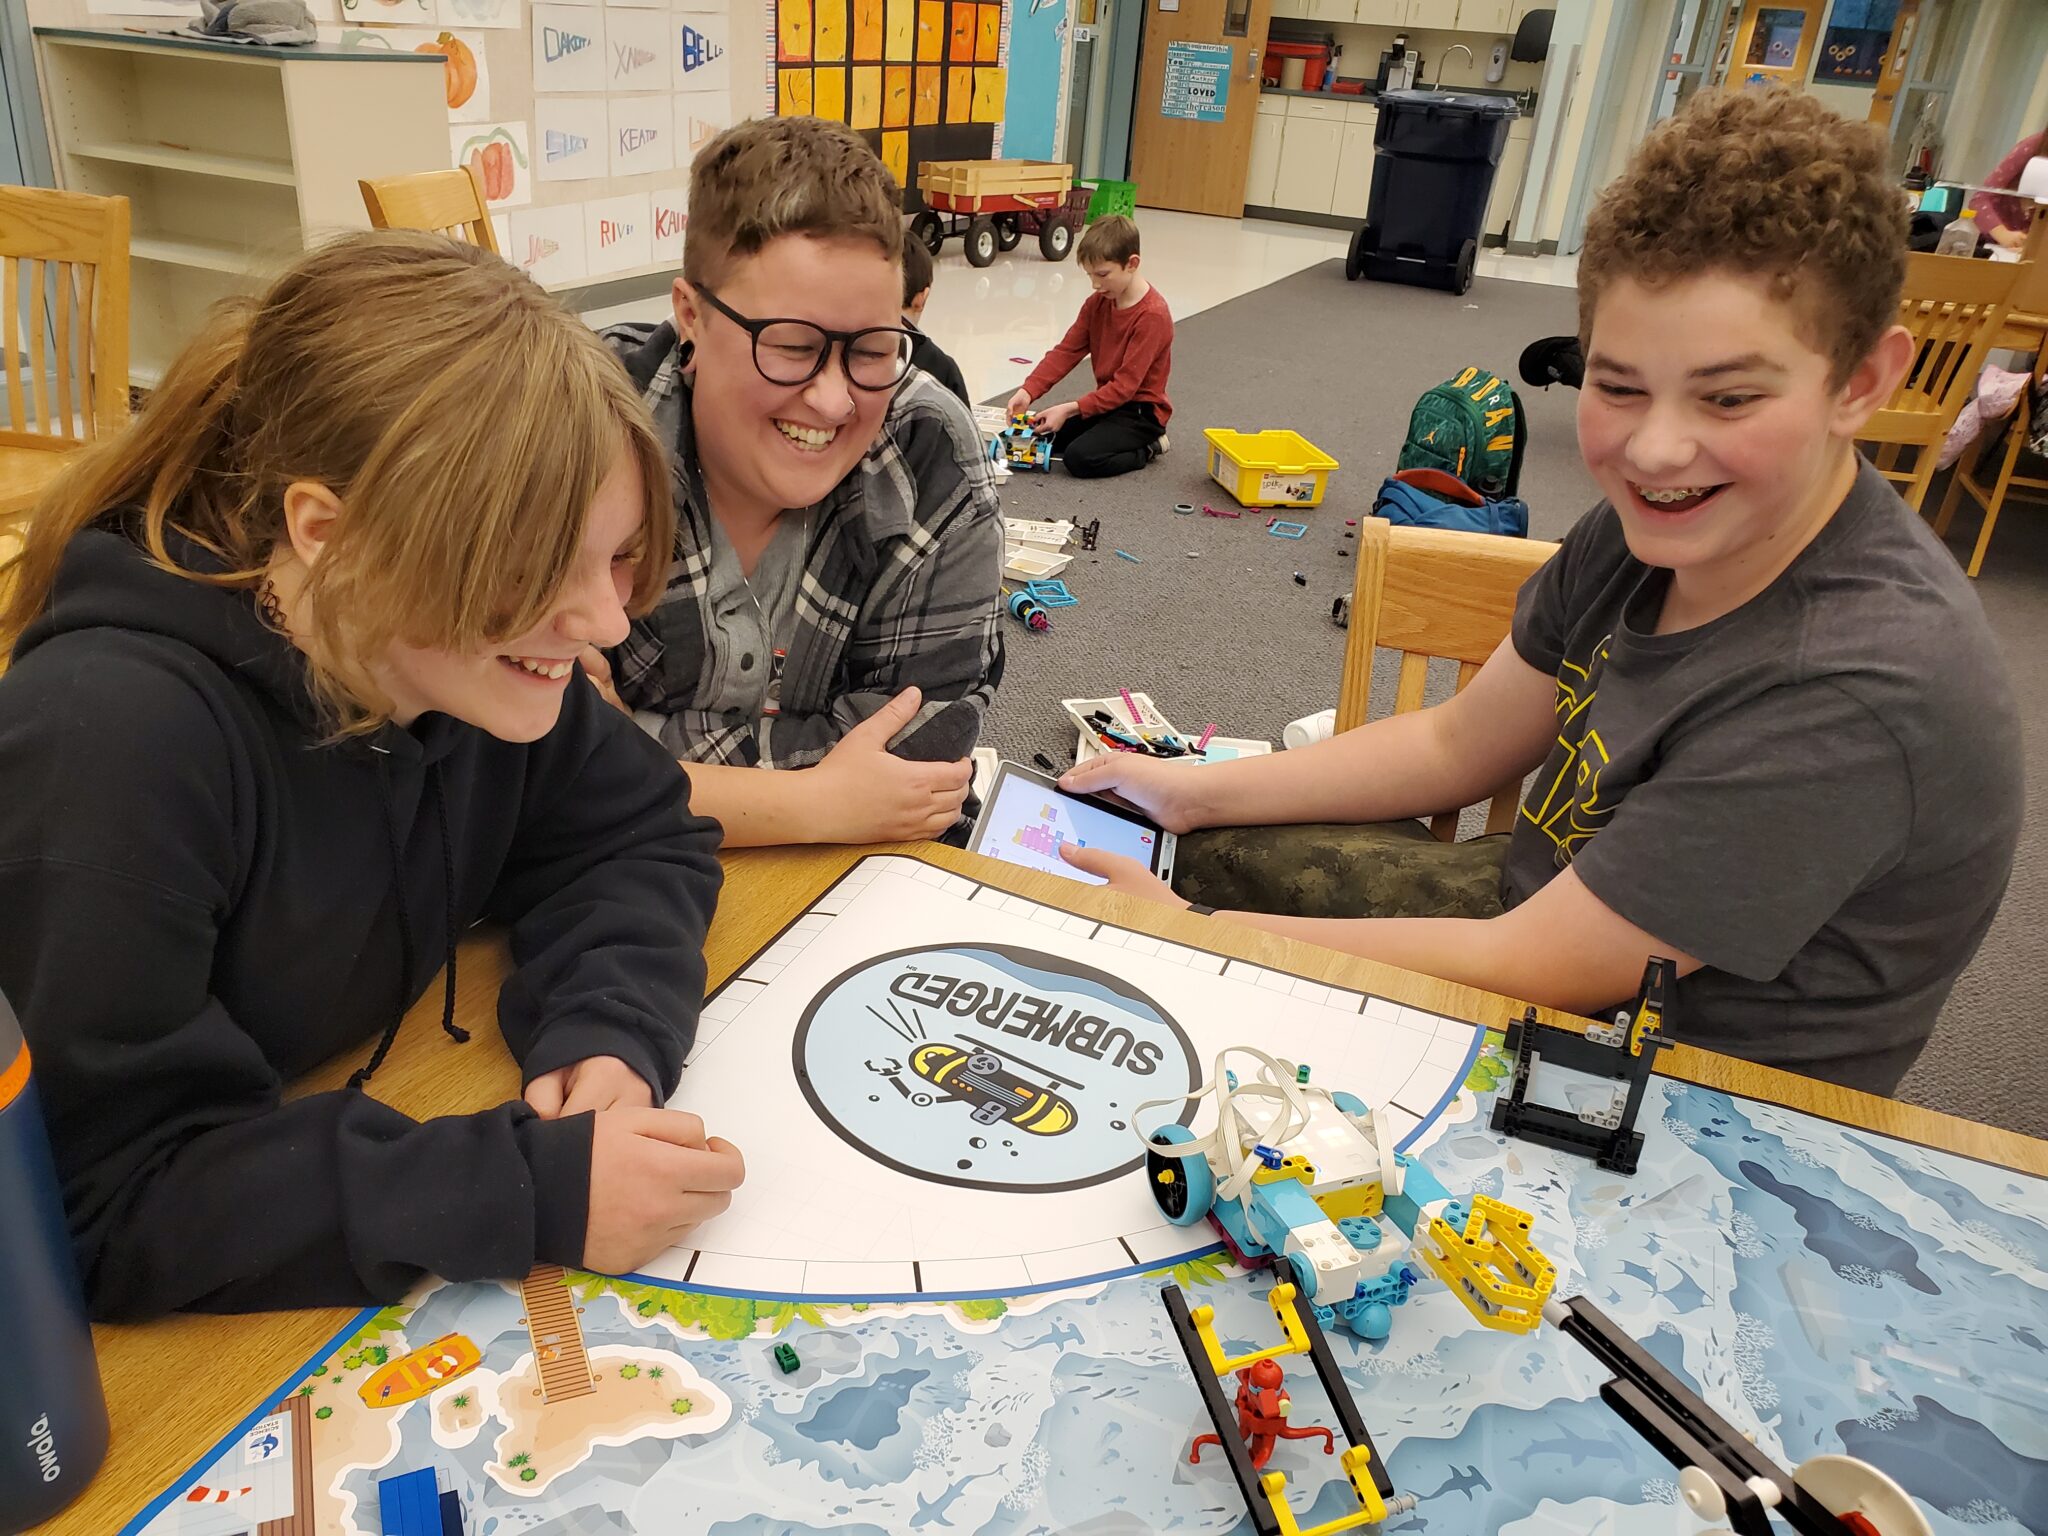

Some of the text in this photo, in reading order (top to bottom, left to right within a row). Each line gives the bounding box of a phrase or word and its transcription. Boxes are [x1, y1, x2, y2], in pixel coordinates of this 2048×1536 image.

[544, 26, 591, 63] DAKOTA
[682, 24, 723, 72] BELLA
[1188, 88, 1216, 97] LOVED
[619, 128, 658, 157] KEATON
[889, 972, 1164, 1075] SUBMERGED
[27, 1416, 60, 1483] owala
